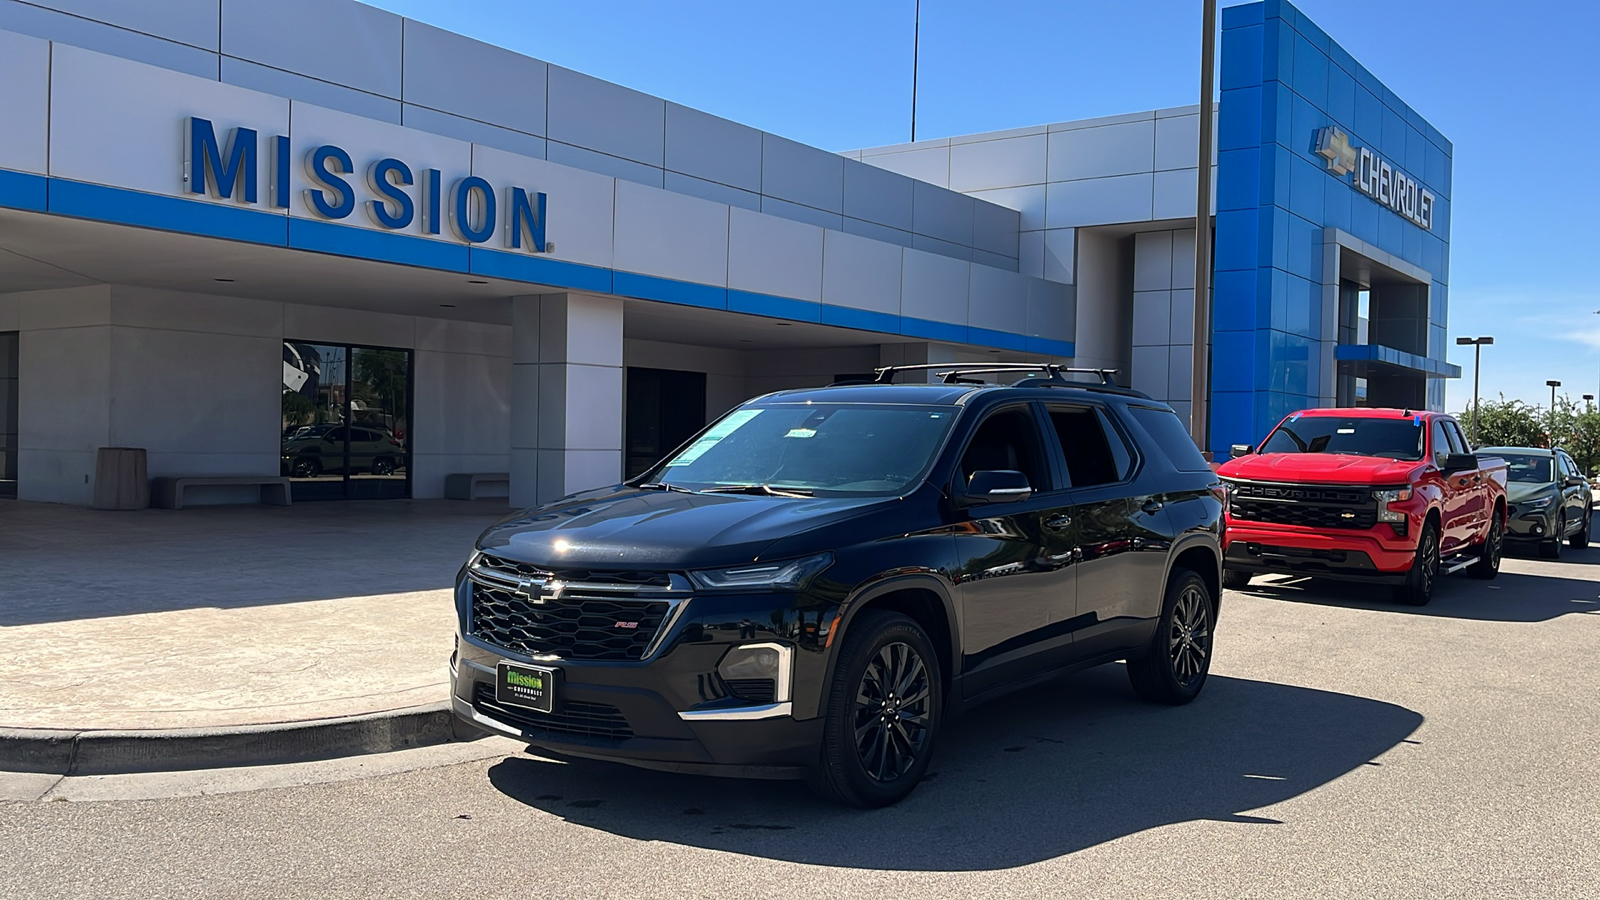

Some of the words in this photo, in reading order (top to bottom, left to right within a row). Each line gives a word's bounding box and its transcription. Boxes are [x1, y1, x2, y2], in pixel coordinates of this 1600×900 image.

[186, 116, 547, 253] MISSION
[1355, 146, 1435, 230] CHEVROLET
[1237, 485, 1363, 501] CHEVROLET
